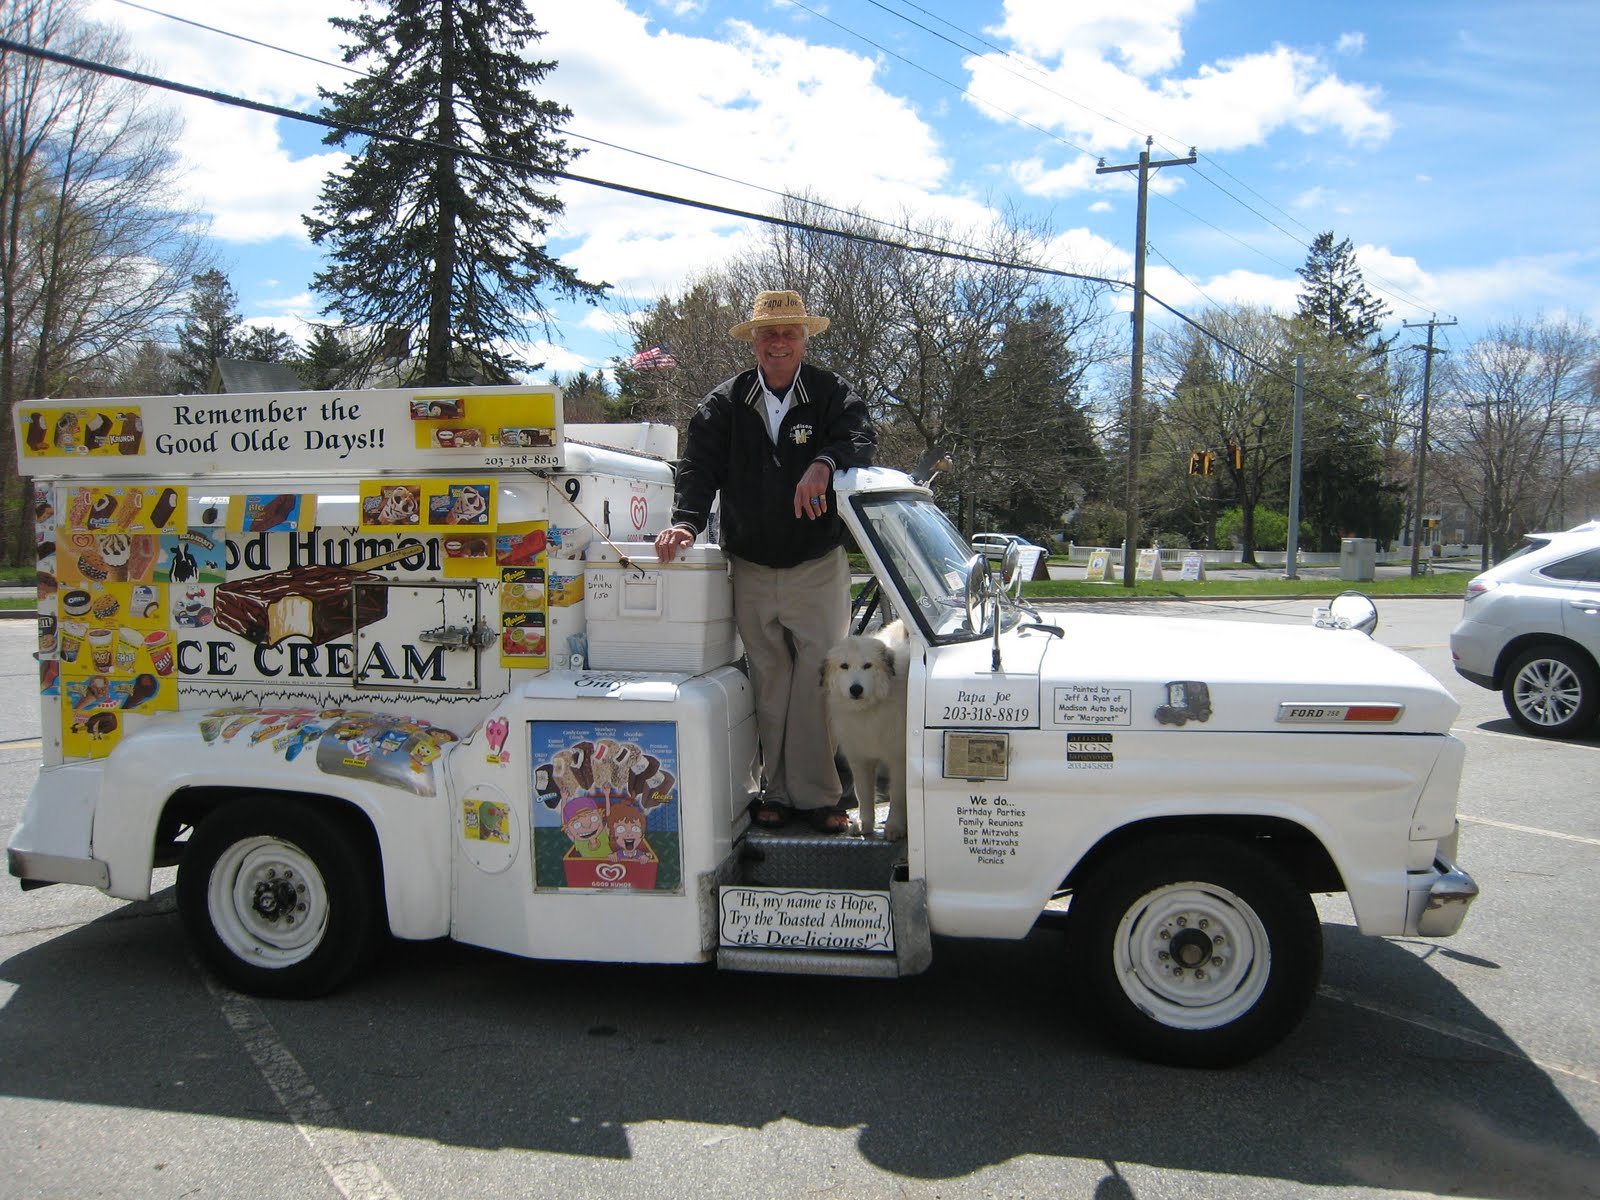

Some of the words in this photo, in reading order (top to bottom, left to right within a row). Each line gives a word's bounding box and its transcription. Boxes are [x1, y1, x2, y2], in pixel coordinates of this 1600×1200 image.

[173, 400, 307, 426] Remember
[320, 398, 362, 422] the
[155, 430, 219, 456] Good
[231, 428, 291, 452] Olde
[304, 427, 385, 459] Days!!
[484, 454, 559, 468] 203-318-8819
[564, 478, 581, 503] 9
[593, 574, 604, 582] All
[254, 641, 447, 682] CREAM
[1072, 685, 1098, 693] Painted
[1101, 686, 1110, 695] by
[957, 690, 986, 703] Papa
[994, 691, 1011, 706] Joe
[1064, 694, 1080, 702] Jeff
[1083, 694, 1089, 702] &
[1093, 694, 1110, 703] Ryan
[1113, 695, 1121, 703] of
[942, 706, 1030, 723] 203-318-8819
[1058, 704, 1087, 712] Madison
[1109, 704, 1128, 714] Body
[1289, 709, 1324, 718] FORD
[1063, 713, 1074, 721] for
[1077, 714, 1119, 723] "Margaret"
[1068, 743, 1112, 752] SIGN
[969, 795, 987, 806] We
[993, 795, 1015, 807] do...
[956, 806, 992, 818] Birthday
[996, 807, 1026, 817] Parties
[958, 817, 984, 828] Family
[988, 818, 1024, 827] Reunions
[963, 827, 978, 836] Bar
[981, 828, 1019, 837] Mitzvahs
[963, 837, 977, 845] Bat
[981, 838, 1019, 847] Mitzvahs
[968, 846, 1007, 857] Weddings
[1010, 848, 1016, 856] &
[977, 856, 1005, 865] Picnics
[736, 891, 760, 909] "Hi,
[763, 897, 784, 911] my
[786, 897, 822, 909] name
[825, 895, 836, 910] is
[840, 895, 877, 914] Hope,
[729, 910, 750, 928] Try
[754, 910, 773, 926] the
[777, 911, 825, 928] Toasted
[830, 914, 886, 931] Almond,
[737, 929, 758, 944] it's
[766, 930, 877, 948] Dee-licious!"
